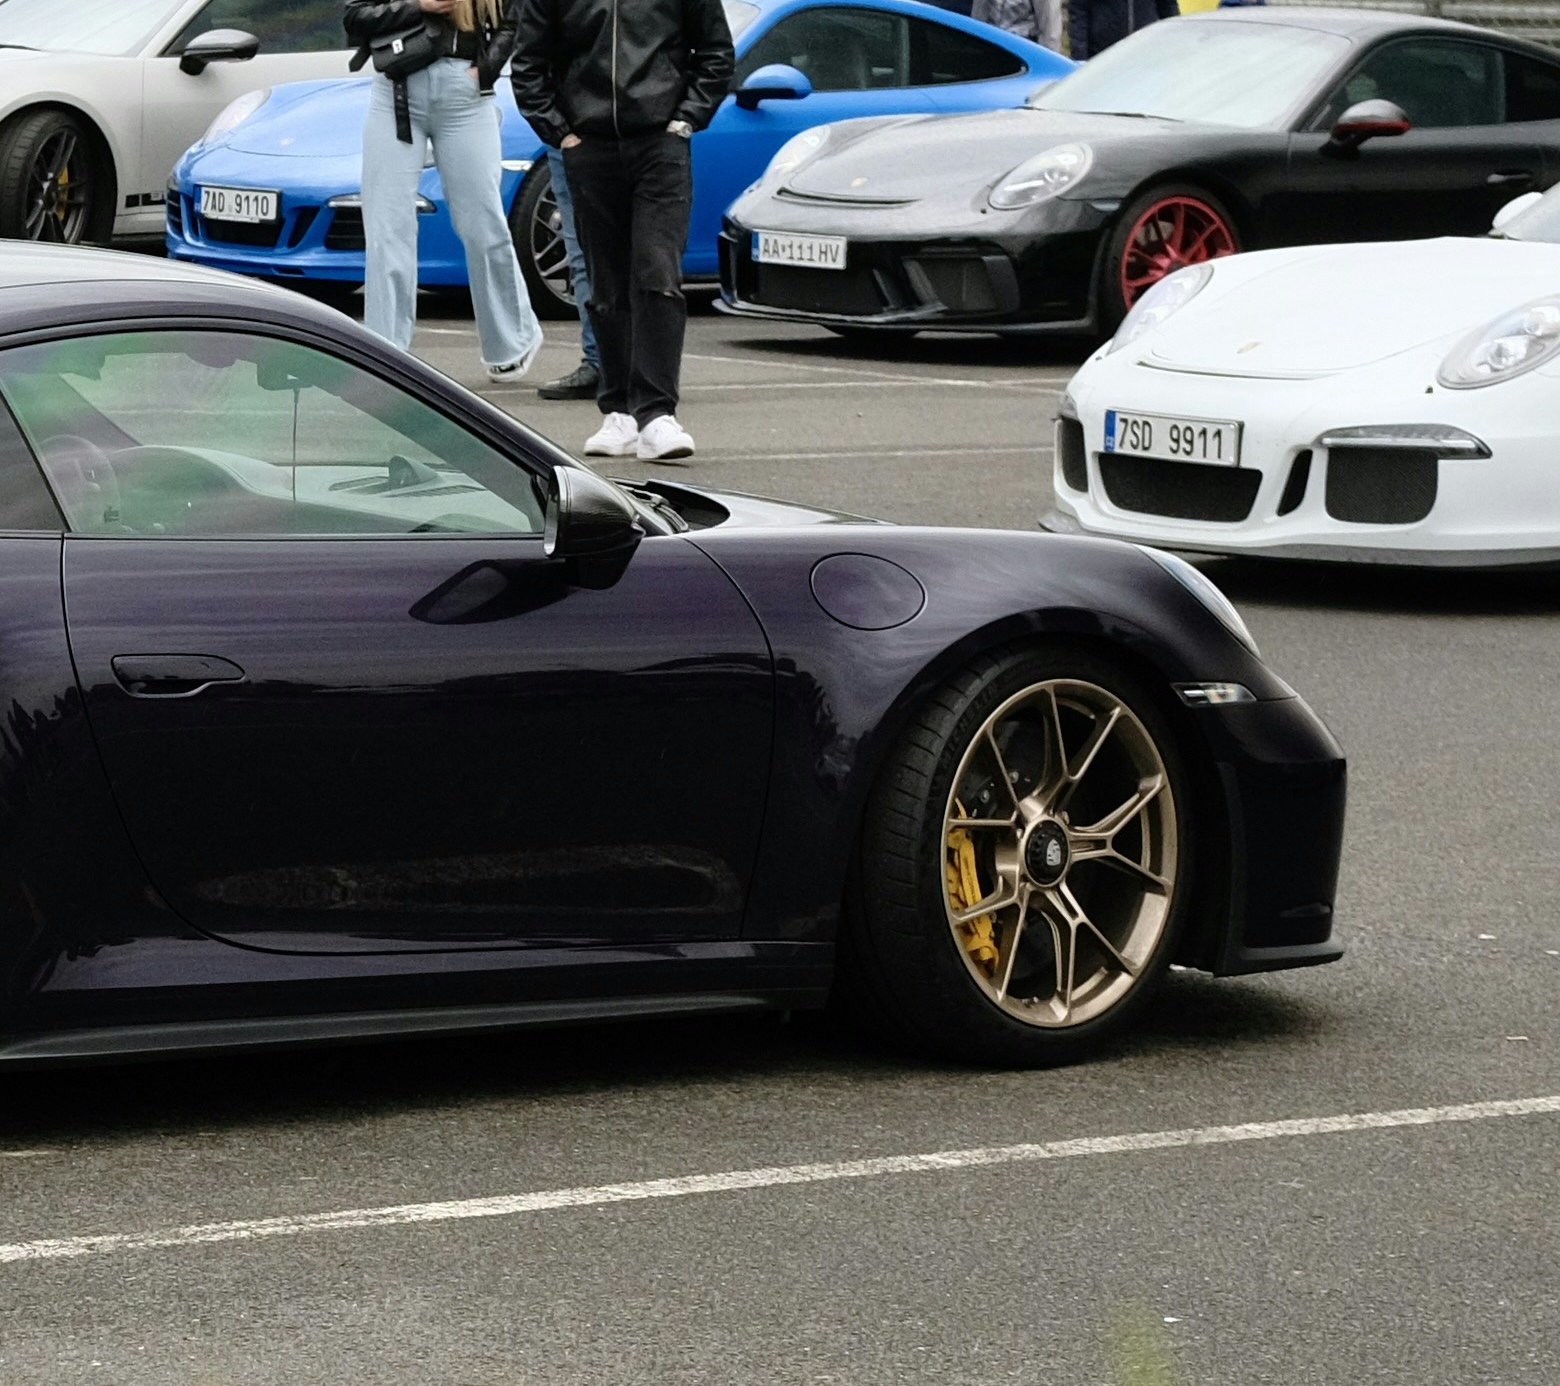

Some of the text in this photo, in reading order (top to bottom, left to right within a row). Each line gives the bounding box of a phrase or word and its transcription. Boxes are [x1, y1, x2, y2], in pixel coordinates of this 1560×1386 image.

[203, 190, 225, 212] 7AD
[235, 193, 269, 216] 9110
[1119, 417, 1222, 459] 7SD 9911
